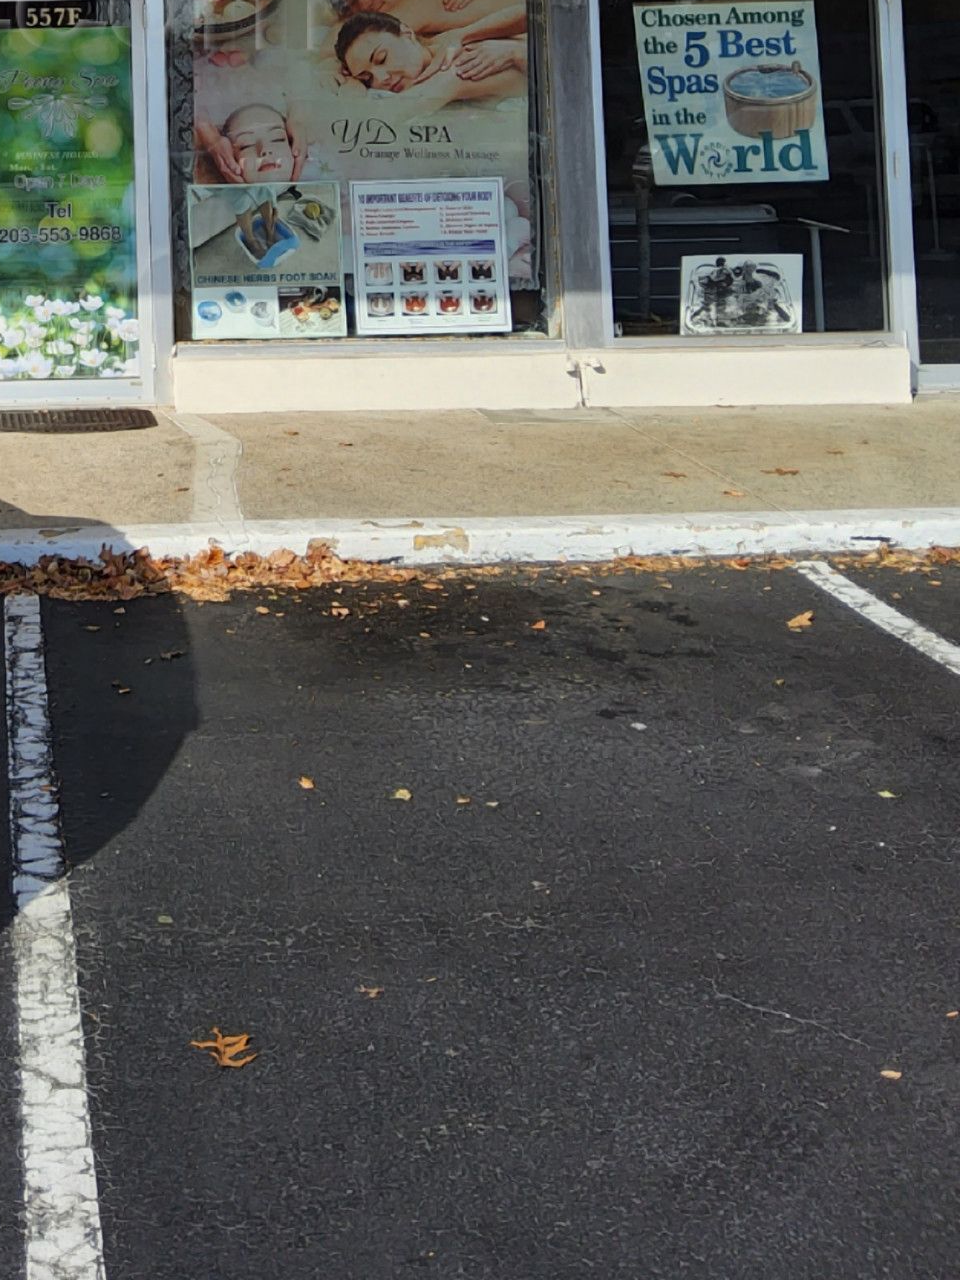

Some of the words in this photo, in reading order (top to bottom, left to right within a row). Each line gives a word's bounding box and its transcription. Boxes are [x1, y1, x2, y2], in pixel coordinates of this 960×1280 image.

[641, 8, 721, 28] Chosen
[725, 6, 805, 27] Among
[643, 36, 678, 55] the
[683, 31, 710, 68] 5
[717, 29, 797, 58] Best
[647, 65, 720, 102] Spas
[652, 109, 669, 126] in
[675, 107, 707, 125] the
[409, 125, 453, 144] SPA
[45, 201, 72, 218] Tel
